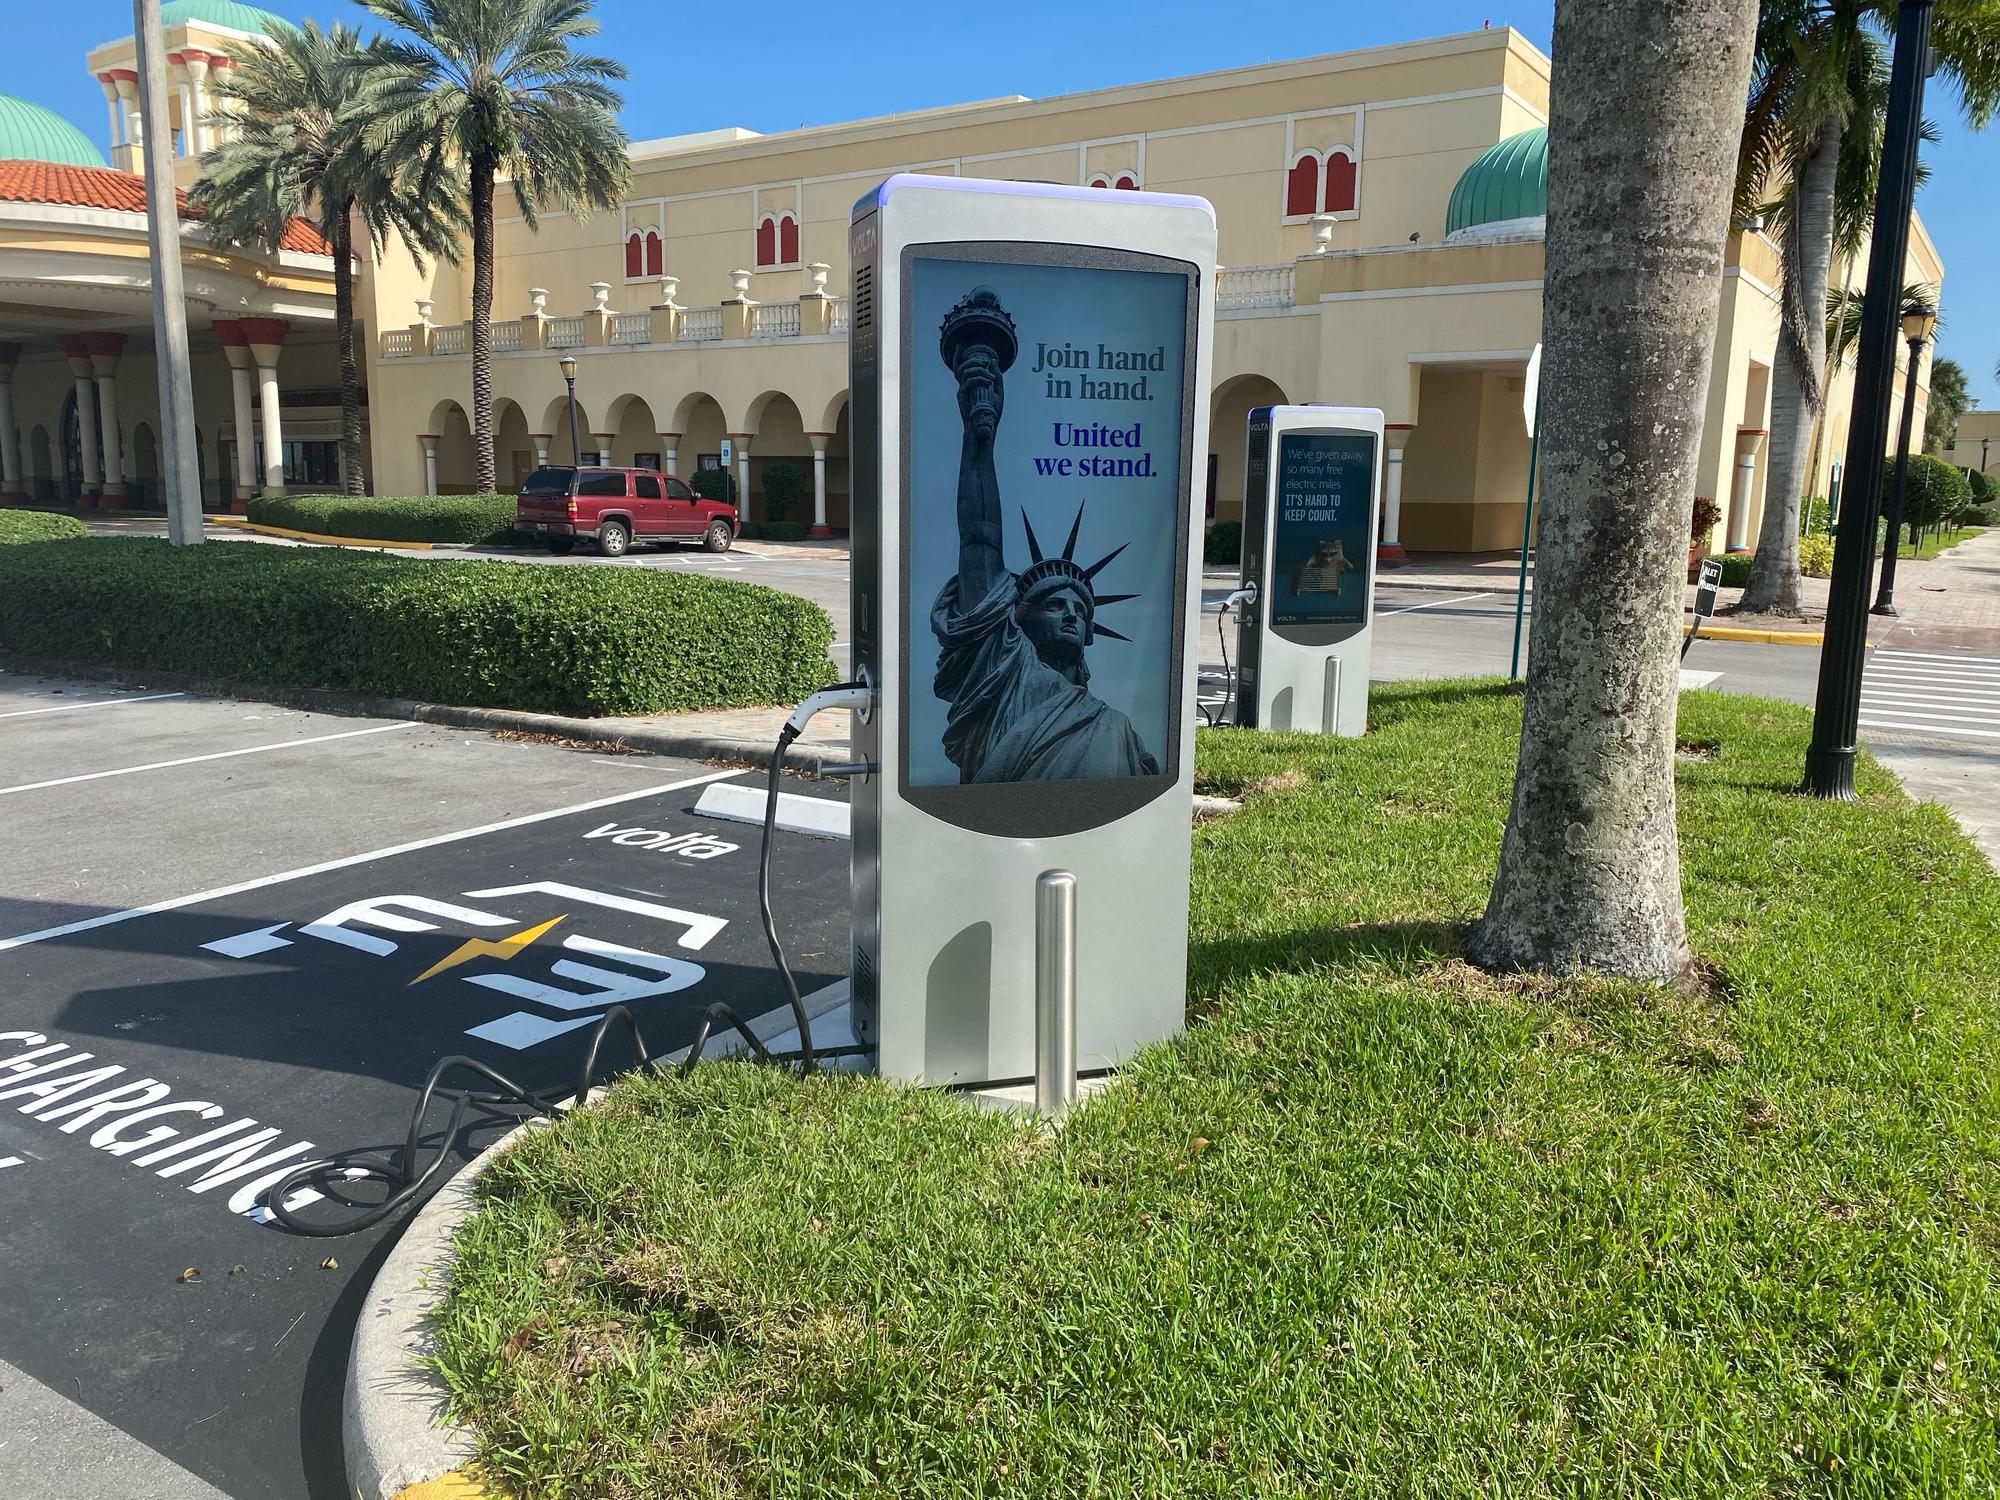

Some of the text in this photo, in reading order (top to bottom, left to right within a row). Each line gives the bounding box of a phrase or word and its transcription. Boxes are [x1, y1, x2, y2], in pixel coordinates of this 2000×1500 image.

[853, 228, 877, 257] VOLTA
[1032, 342, 1165, 373] Join hand
[1045, 372, 1154, 401] in hand.
[1053, 422, 1142, 448] United
[1250, 423, 1269, 431] VOLTA
[1033, 452, 1158, 477] we stand.
[1287, 448, 1364, 462] We've given away
[1287, 463, 1344, 476] so many free
[1286, 478, 1342, 489] electric miles
[1285, 494, 1341, 507] IT'S HARD TO
[1284, 509, 1337, 521] KEEP COUNT.
[582, 822, 741, 859] volta
